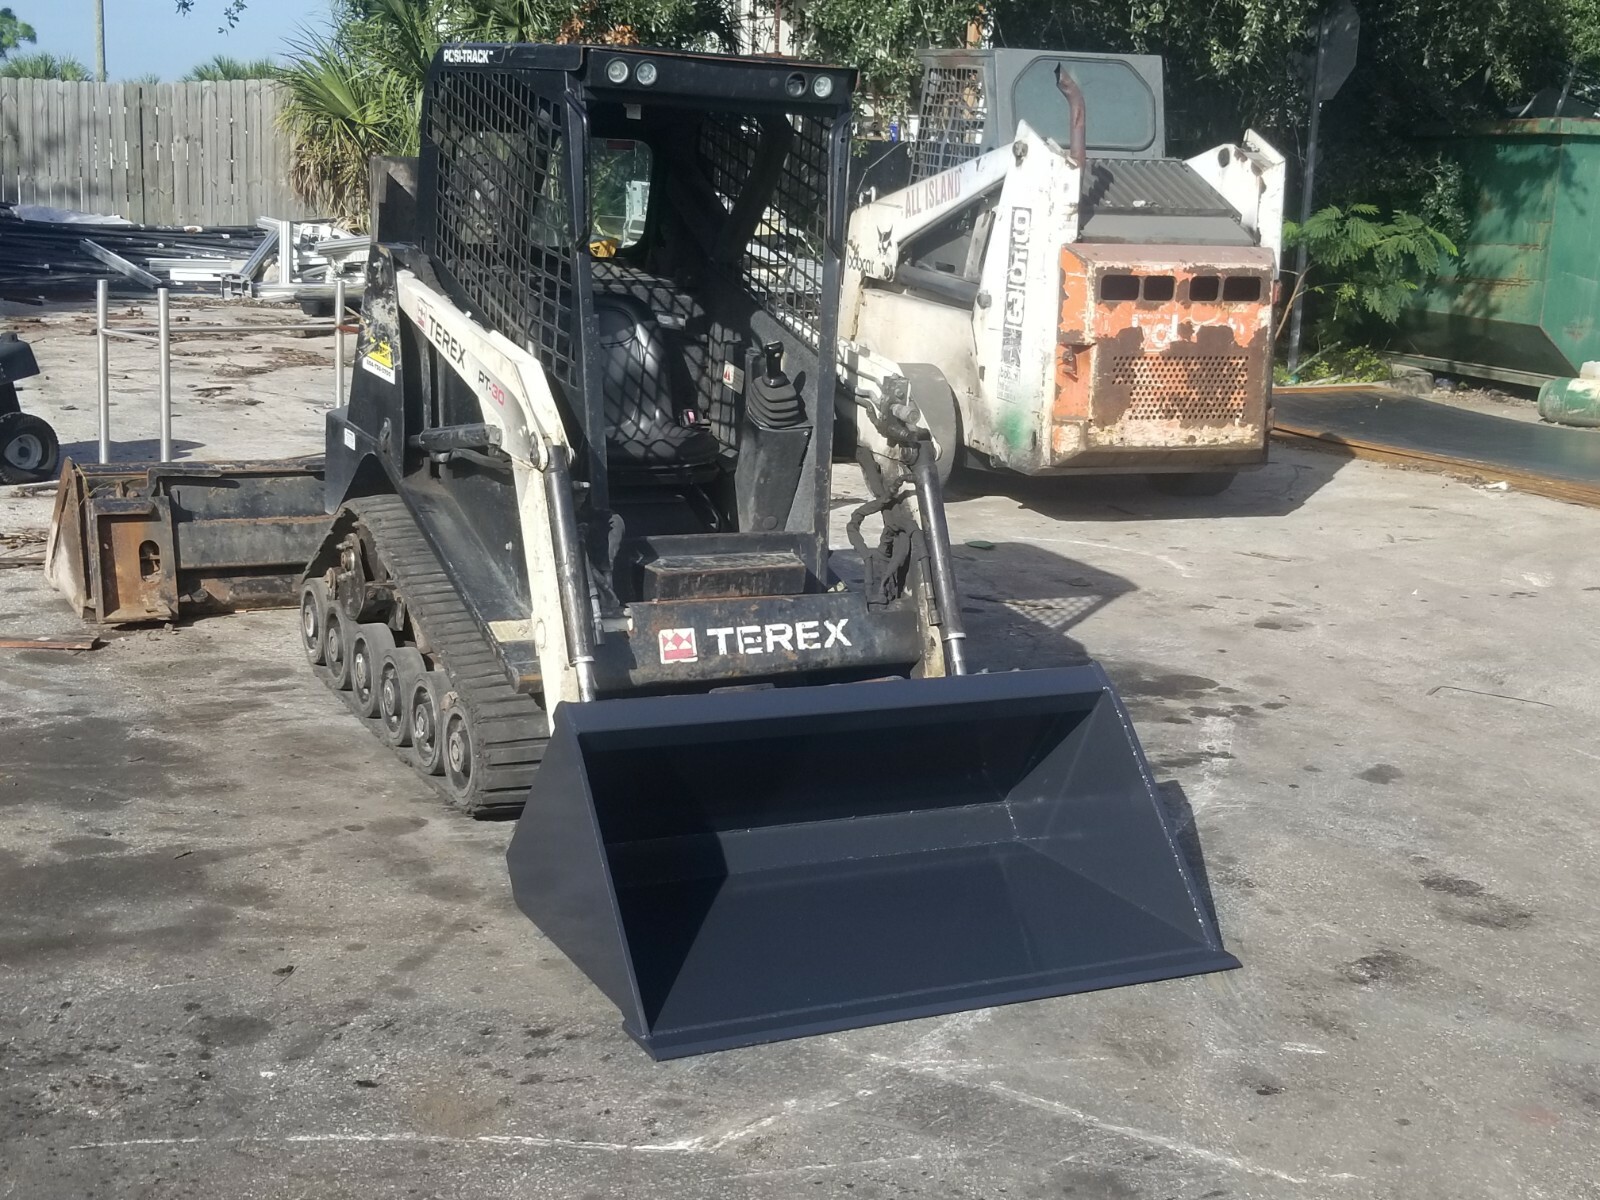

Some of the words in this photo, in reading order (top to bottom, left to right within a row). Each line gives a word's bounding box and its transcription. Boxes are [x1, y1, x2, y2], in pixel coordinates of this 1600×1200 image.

[905, 187, 921, 219] ALL
[925, 170, 961, 210] ISLAND
[429, 314, 467, 370] TEREX
[478, 370, 505, 406] PT-30
[706, 618, 853, 655] TEREX
